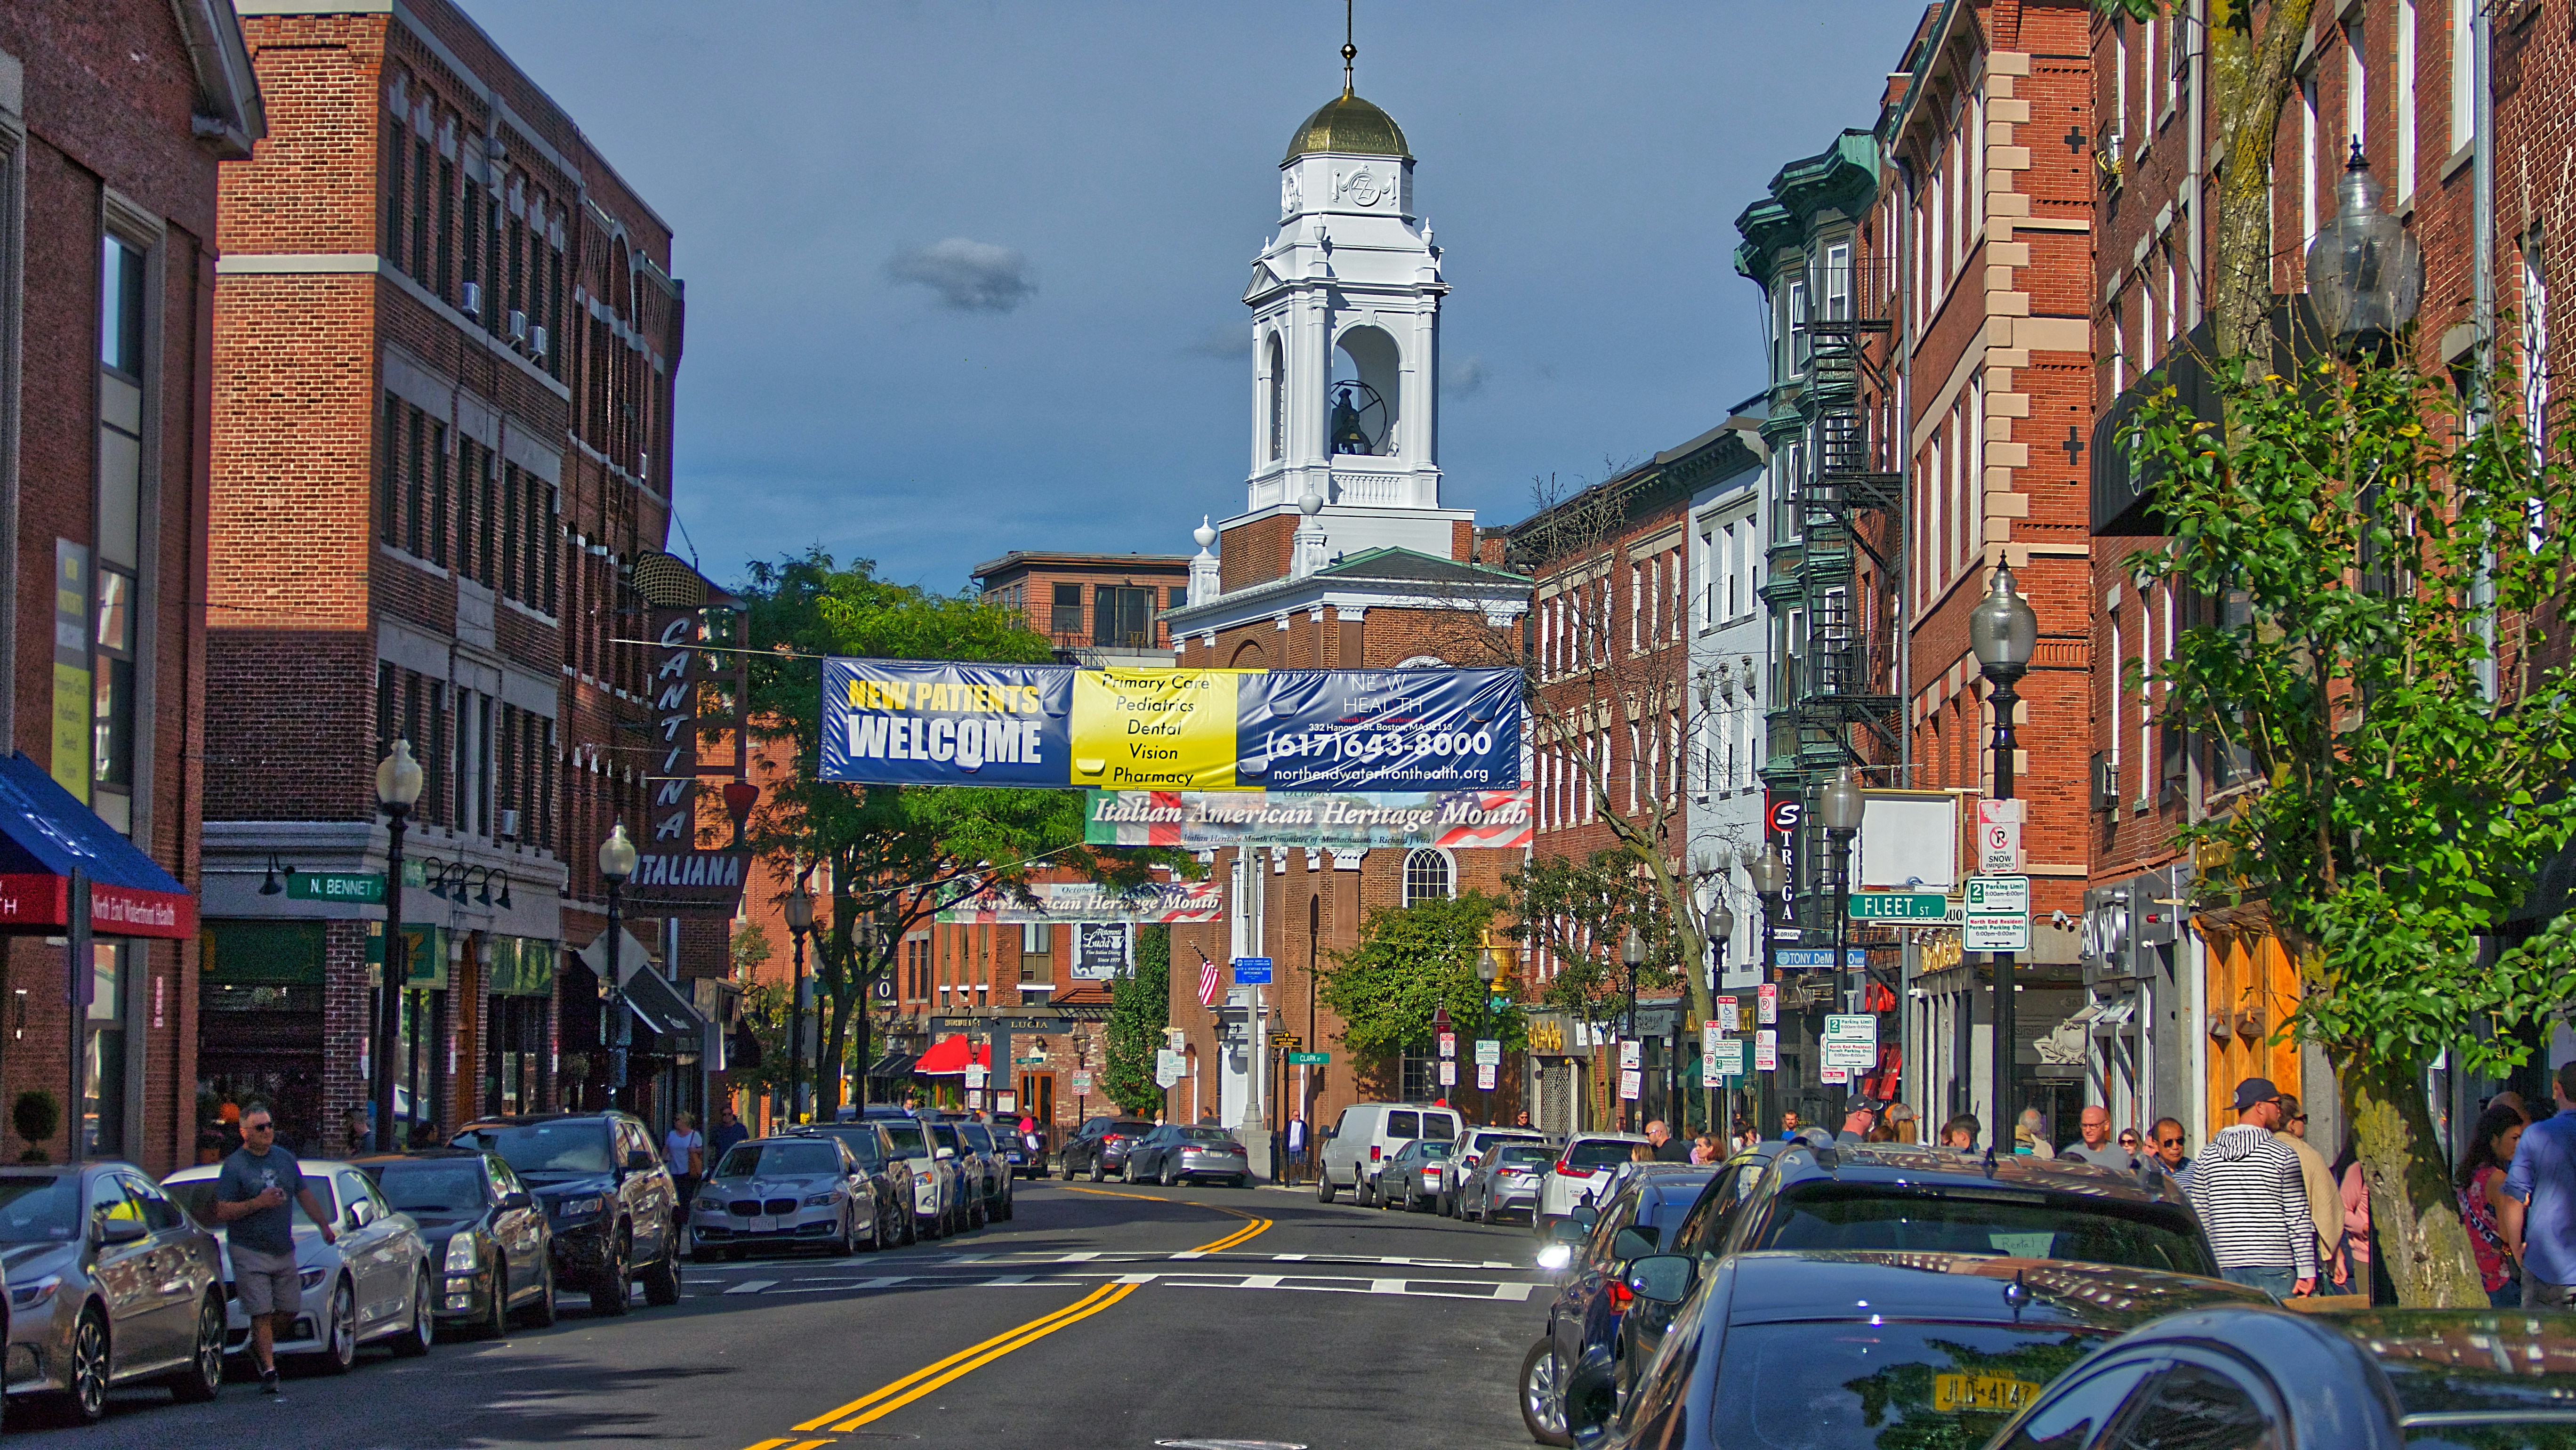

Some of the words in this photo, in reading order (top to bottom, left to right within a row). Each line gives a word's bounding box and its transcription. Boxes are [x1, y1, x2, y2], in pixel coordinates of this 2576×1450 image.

[1102, 674, 1165, 692] Primary
[1172, 675, 1209, 689] Care
[848, 680, 910, 709] NEW
[915, 682, 1038, 713] PATIENTS
[1116, 695, 1194, 712] Pediatrics
[656, 617, 691, 841] CANTINA
[1127, 719, 1182, 735] Dental
[1327, 724, 1363, 732] Hanover
[1378, 724, 1408, 732] Boston,
[848, 715, 1041, 763] WELCOME
[1267, 732, 1491, 761] (617)643-8000
[1130, 743, 1178, 759] Vision
[1113, 767, 1194, 786] Pharmacy
[1274, 765, 1488, 782] northendwaterfronthealth.org
[1092, 798, 1182, 822] Italian
[1185, 801, 1312, 824] American
[1320, 801, 1433, 832] Heritage
[1438, 801, 1527, 825] Month
[1211, 835, 1241, 845] Heritage
[1243, 835, 1267, 843] Month
[1270, 835, 1308, 843] Committee
[1311, 836, 1318, 845] of
[1321, 836, 1372, 844] Massachusetts
[1408, 837, 1413, 845] J
[630, 854, 738, 886] ITALIANA
[311, 878, 321, 893] N.
[327, 879, 372, 895] BENNET
[1973, 884, 1981, 895] 2
[1162, 894, 1218, 909] Month
[1865, 898, 1913, 915] FLEET
[1920, 907, 1929, 915] ST
[1790, 953, 1811, 964] TONY
[1832, 1020, 1838, 1028] 2
[2002, 1236, 2034, 1249] Rental
